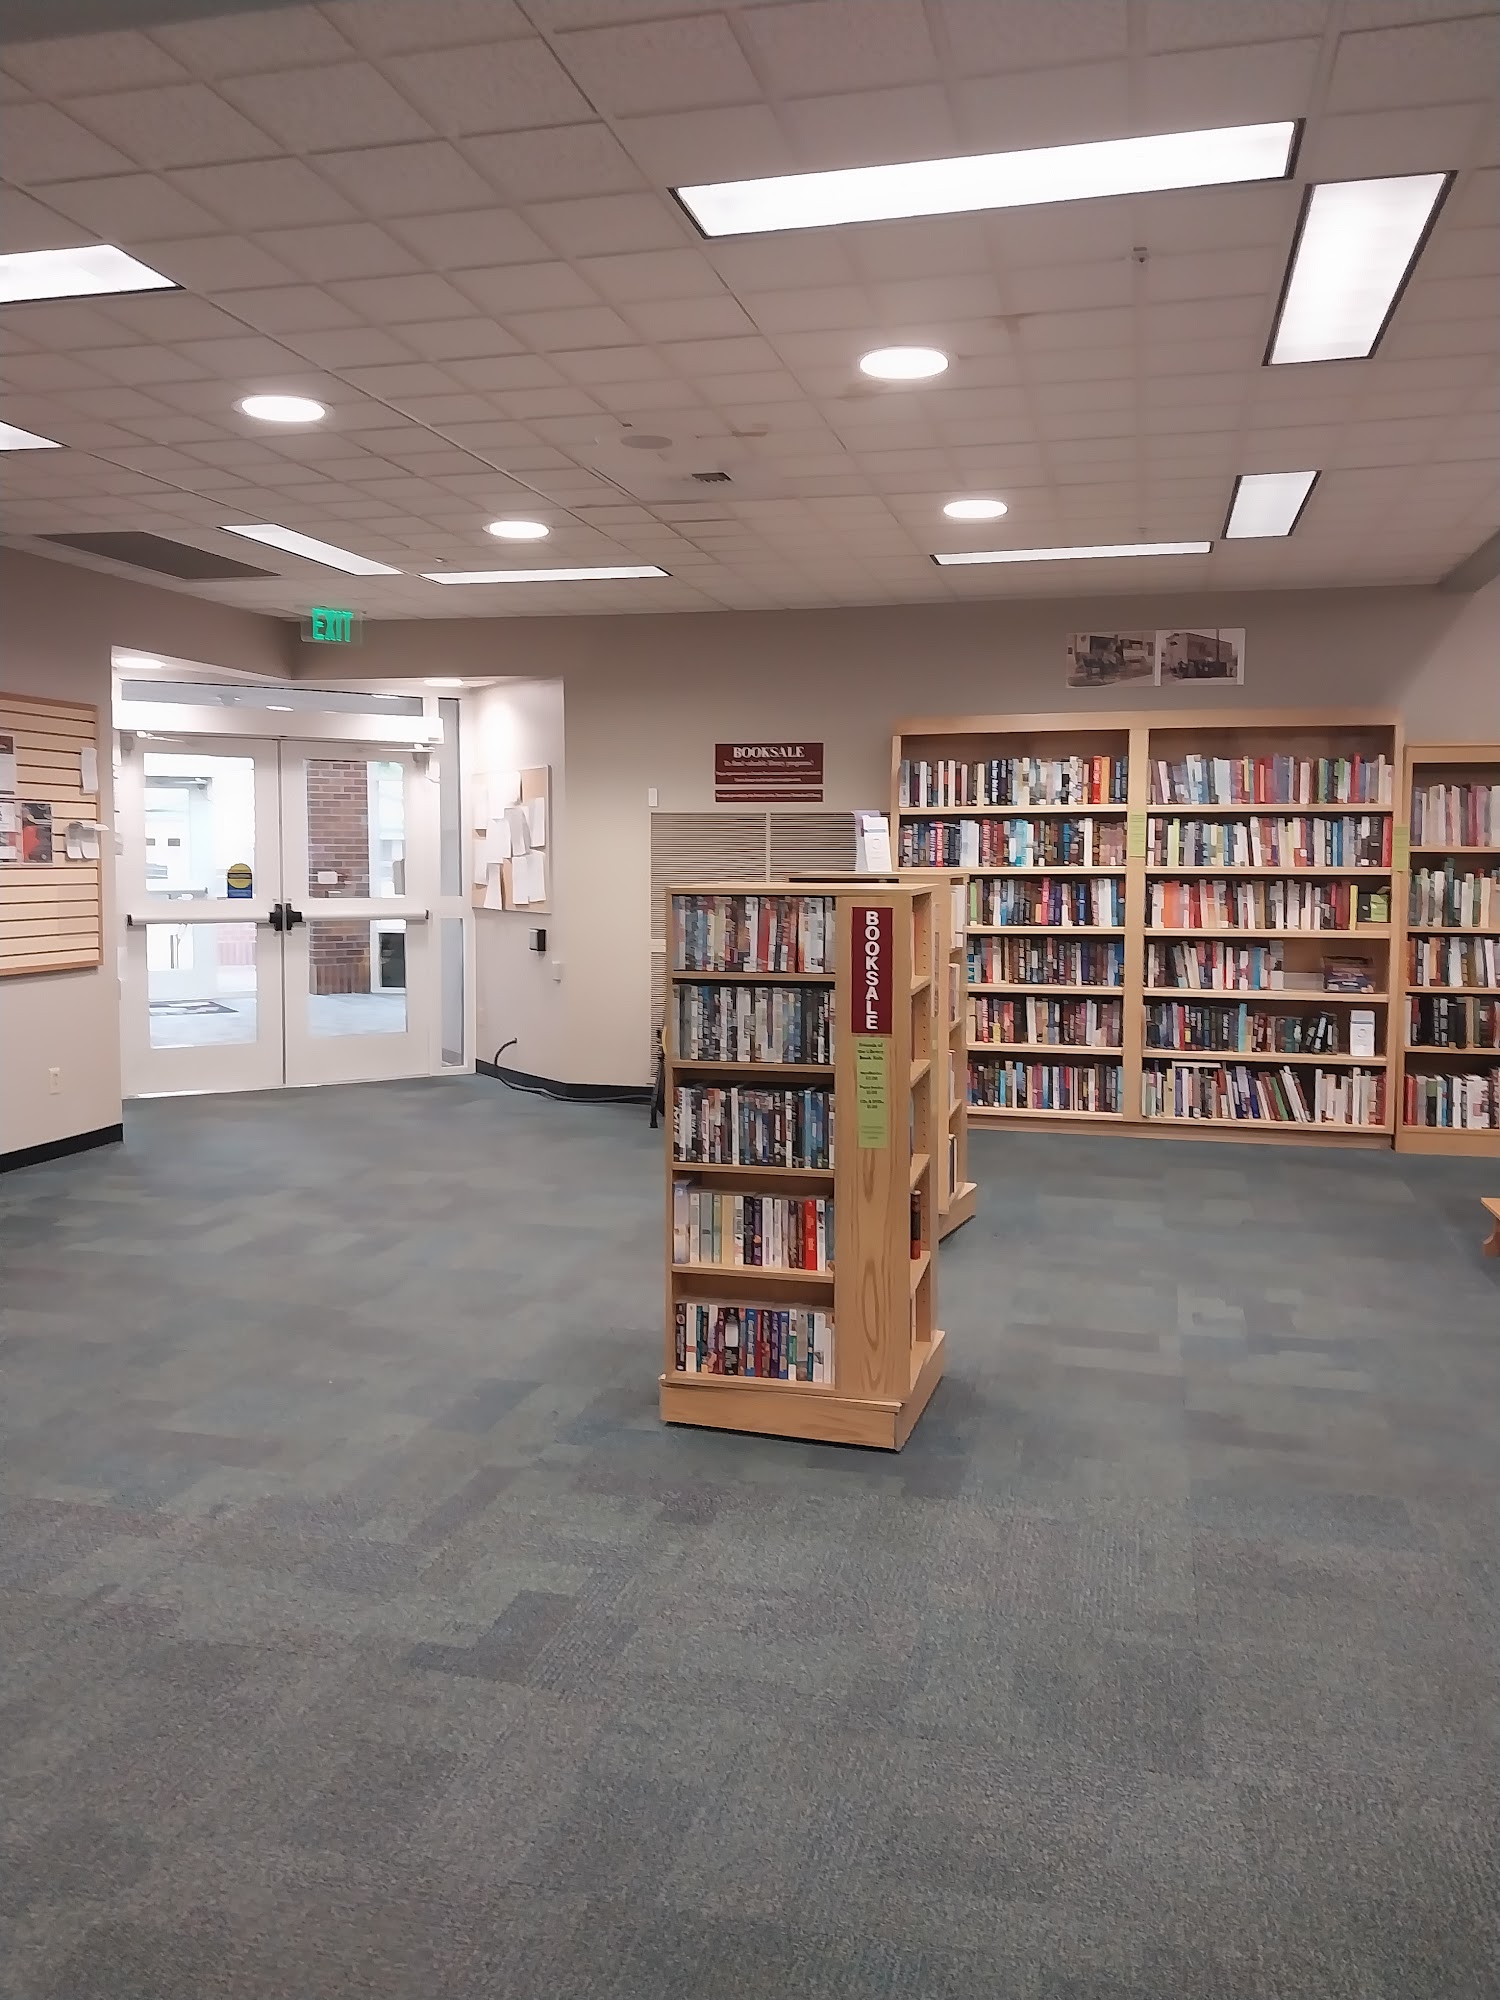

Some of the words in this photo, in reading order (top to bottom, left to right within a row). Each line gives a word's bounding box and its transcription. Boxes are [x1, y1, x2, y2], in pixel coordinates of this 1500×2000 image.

[312, 607, 354, 643] EXIT
[732, 746, 805, 758] BOOKSALE
[865, 911, 880, 1030] BOOKSALE
